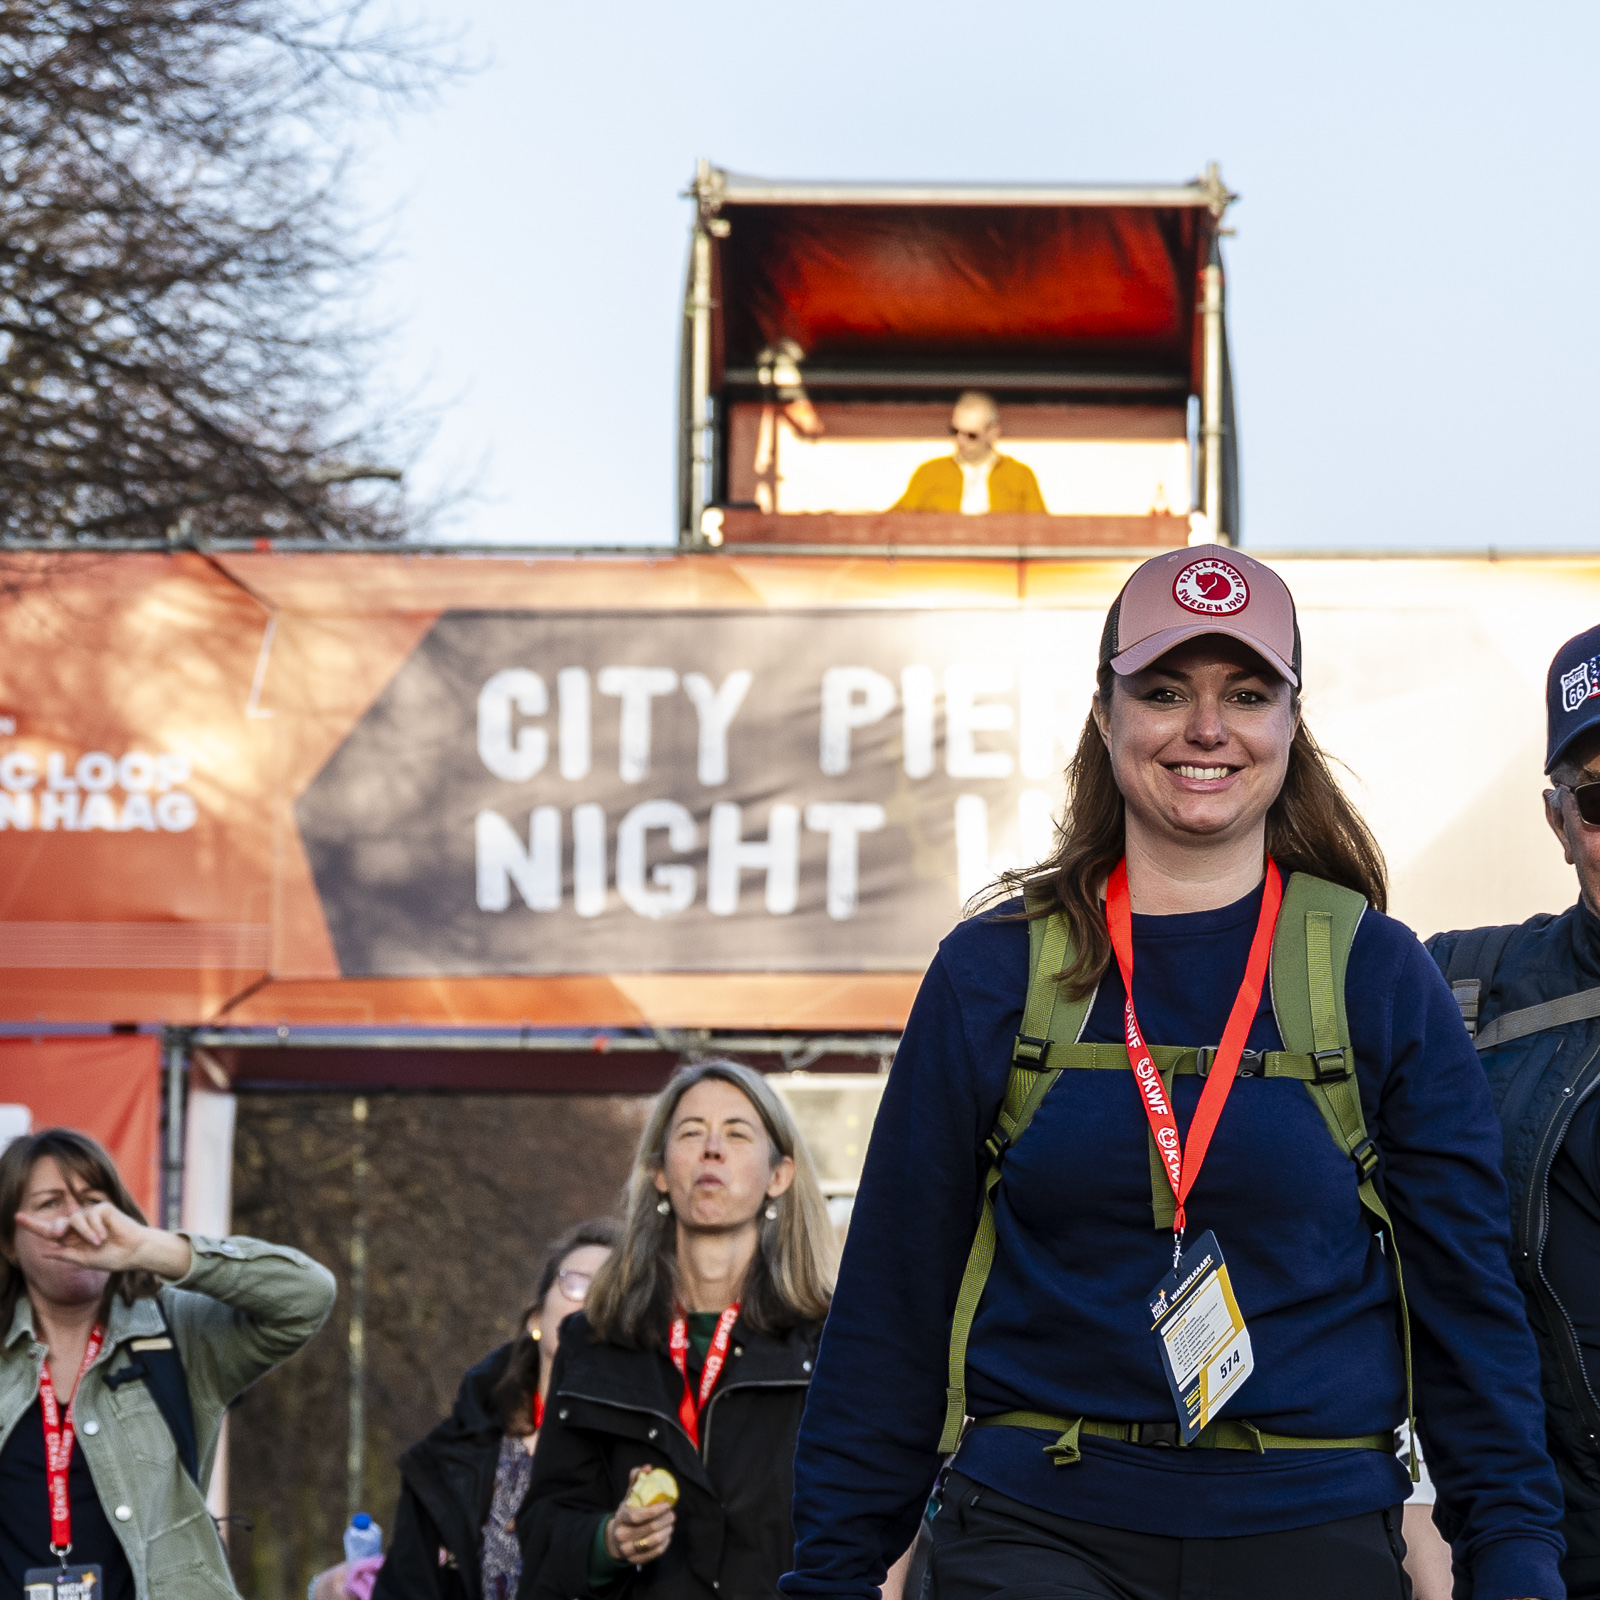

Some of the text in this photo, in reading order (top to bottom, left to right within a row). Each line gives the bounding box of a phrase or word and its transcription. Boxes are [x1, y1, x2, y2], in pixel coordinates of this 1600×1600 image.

[1179, 561, 1244, 588] FJÄLLRÄVEN
[1178, 588, 1245, 611] SWEDEN 1960
[1564, 670, 1585, 687] ROUTE
[1569, 683, 1585, 705] 66
[476, 666, 752, 785] CITY
[48, 751, 193, 792] LOOP
[40, 790, 200, 832] HAAG
[475, 799, 886, 918] NIGHT
[1142, 1076, 1169, 1117] KWF
[1164, 1149, 1182, 1189] KW
[1170, 1254, 1212, 1302] WANDELKAART
[1219, 1349, 1240, 1379] 574
